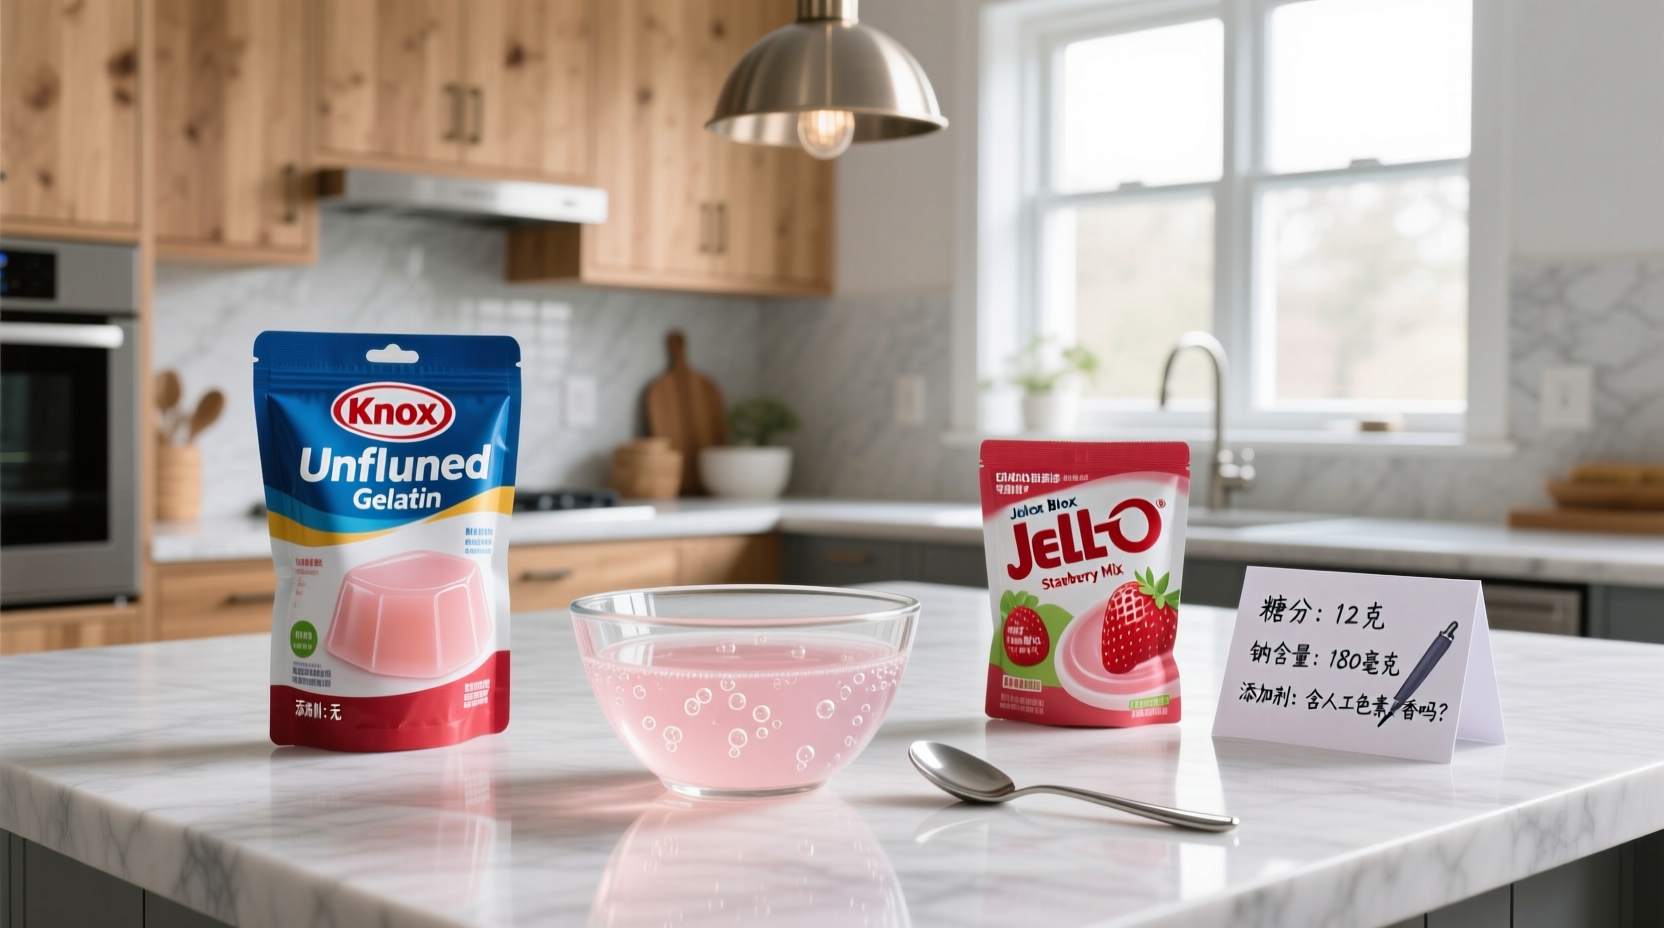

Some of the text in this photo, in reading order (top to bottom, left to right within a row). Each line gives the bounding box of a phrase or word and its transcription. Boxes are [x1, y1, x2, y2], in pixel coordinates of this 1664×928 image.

[348, 396, 438, 426] Knox
[300, 444, 491, 483] Unfluned
[353, 487, 442, 510] Gelatin
